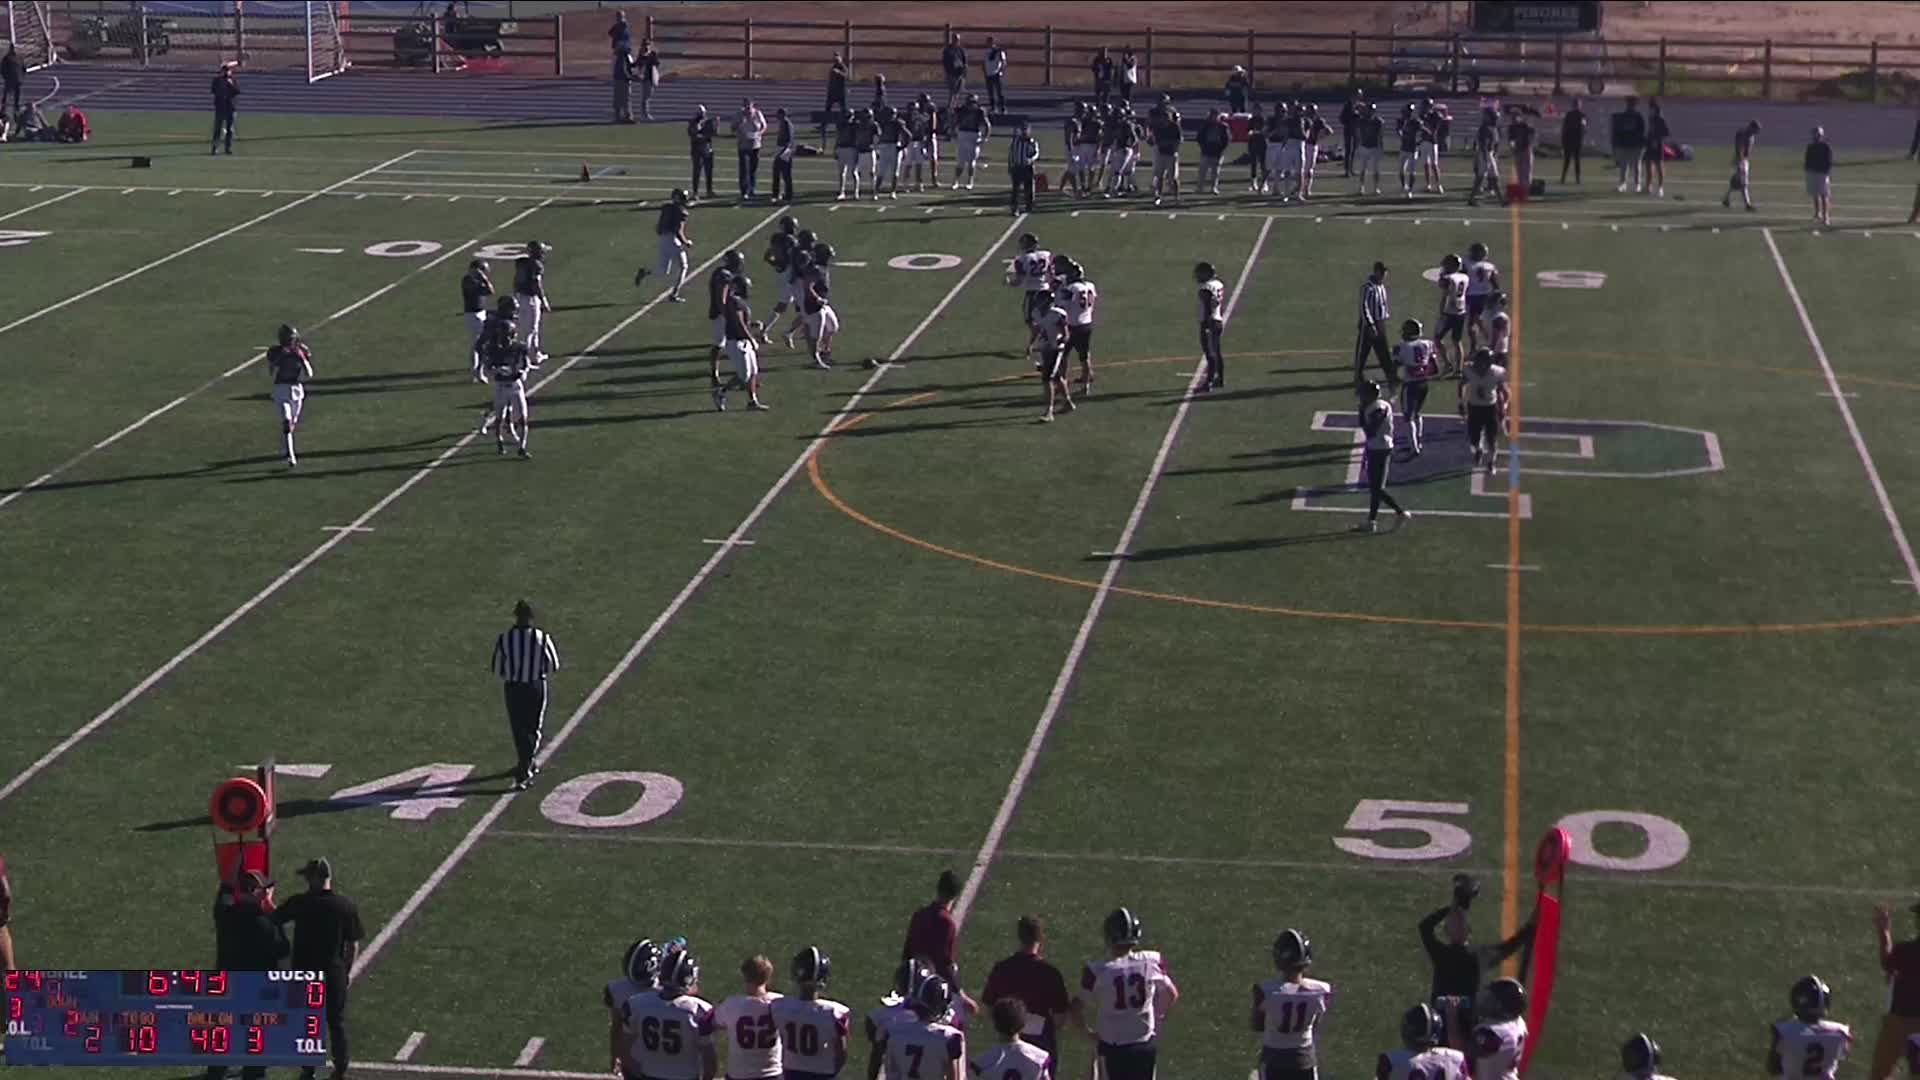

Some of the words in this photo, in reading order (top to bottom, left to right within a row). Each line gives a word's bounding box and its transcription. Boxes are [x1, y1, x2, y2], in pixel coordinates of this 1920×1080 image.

[1113, 974, 1146, 1010] 13
[736, 1015, 776, 1050] 62
[1277, 1001, 1307, 1034] 11
[641, 1015, 683, 1056] 65
[784, 1021, 820, 1057] 10
[905, 1044, 925, 1079] 7
[1802, 1041, 1825, 1073] 2
